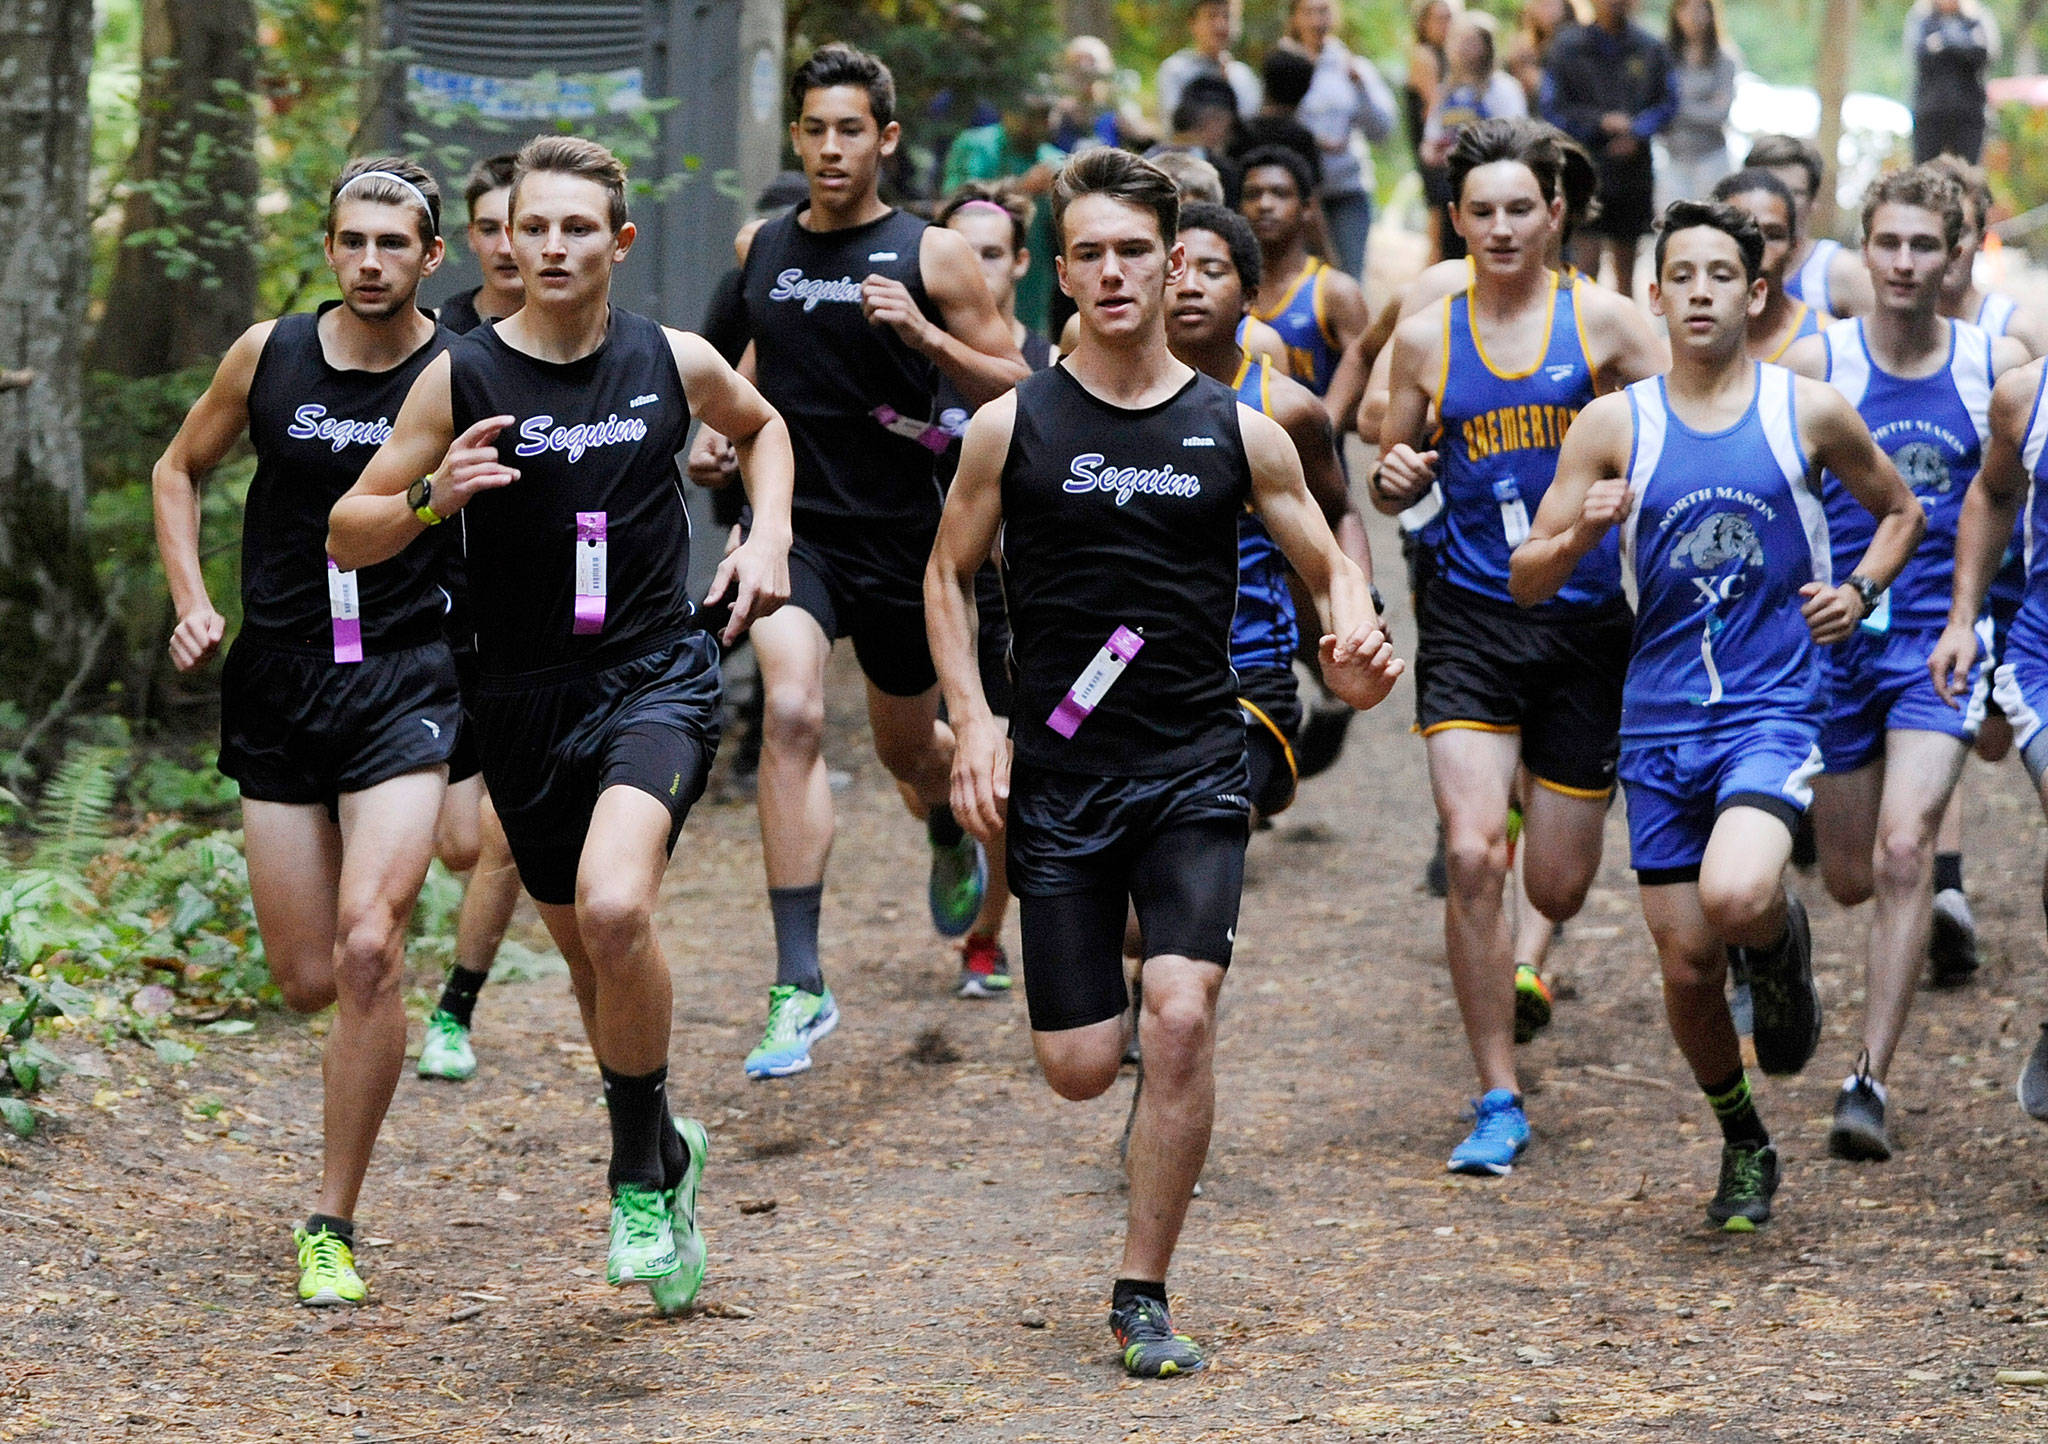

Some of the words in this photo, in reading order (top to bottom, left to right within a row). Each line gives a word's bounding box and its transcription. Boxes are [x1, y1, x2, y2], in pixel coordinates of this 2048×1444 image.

[515, 413, 648, 464] Sequim
[1871, 420, 1911, 440] ORTH
[1062, 453, 1201, 506] Sequim
[1715, 487, 1777, 521] MASON
[1690, 574, 1746, 602] XC
